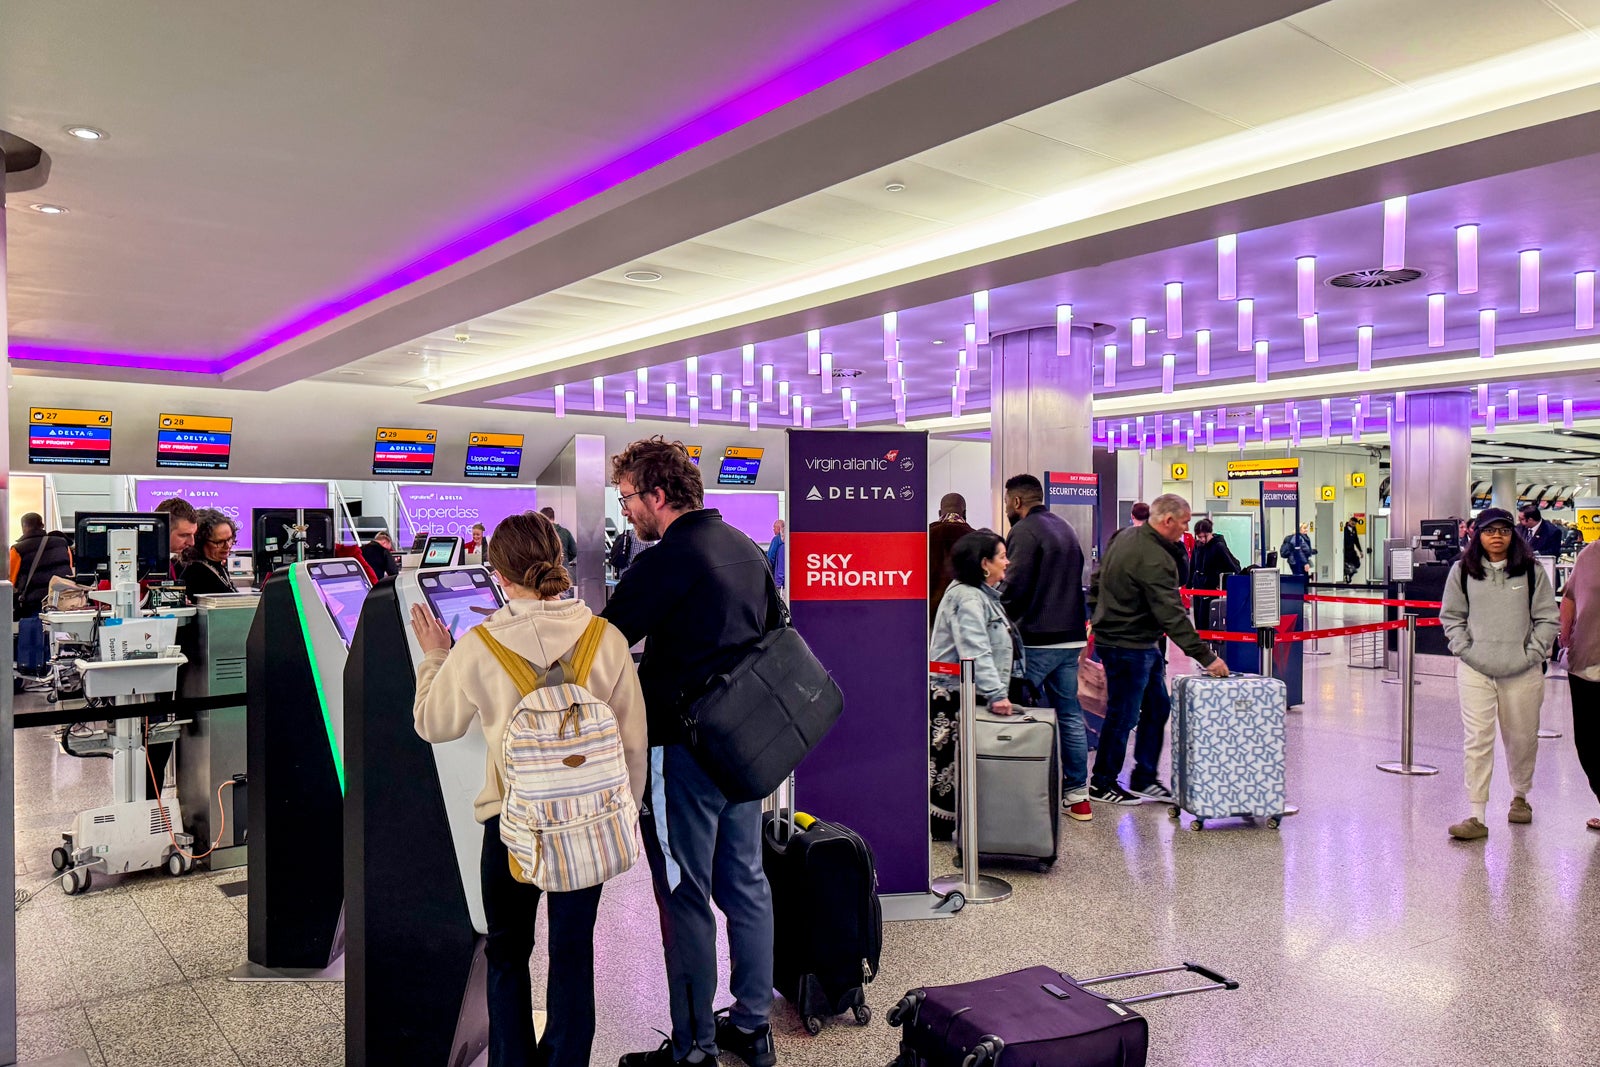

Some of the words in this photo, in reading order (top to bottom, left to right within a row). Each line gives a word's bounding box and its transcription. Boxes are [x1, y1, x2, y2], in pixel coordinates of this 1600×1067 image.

[46, 412, 58, 420] 27
[174, 418, 184, 426] 28
[57, 429, 86, 437] DELTA
[470, 455, 490, 463] Upper
[805, 457, 842, 473] virgin
[842, 457, 888, 471] atlantic
[829, 486, 896, 500] DELTA
[1049, 487, 1078, 496] SECURITY
[1078, 488, 1098, 497] CHECK
[1264, 493, 1283, 501] SECURITY
[1283, 493, 1297, 501] CHECK
[409, 505, 479, 520] upperclass
[409, 522, 444, 535] Delta
[447, 522, 473, 535] One
[806, 554, 853, 570] SKY
[806, 570, 912, 587] PRIORITY
